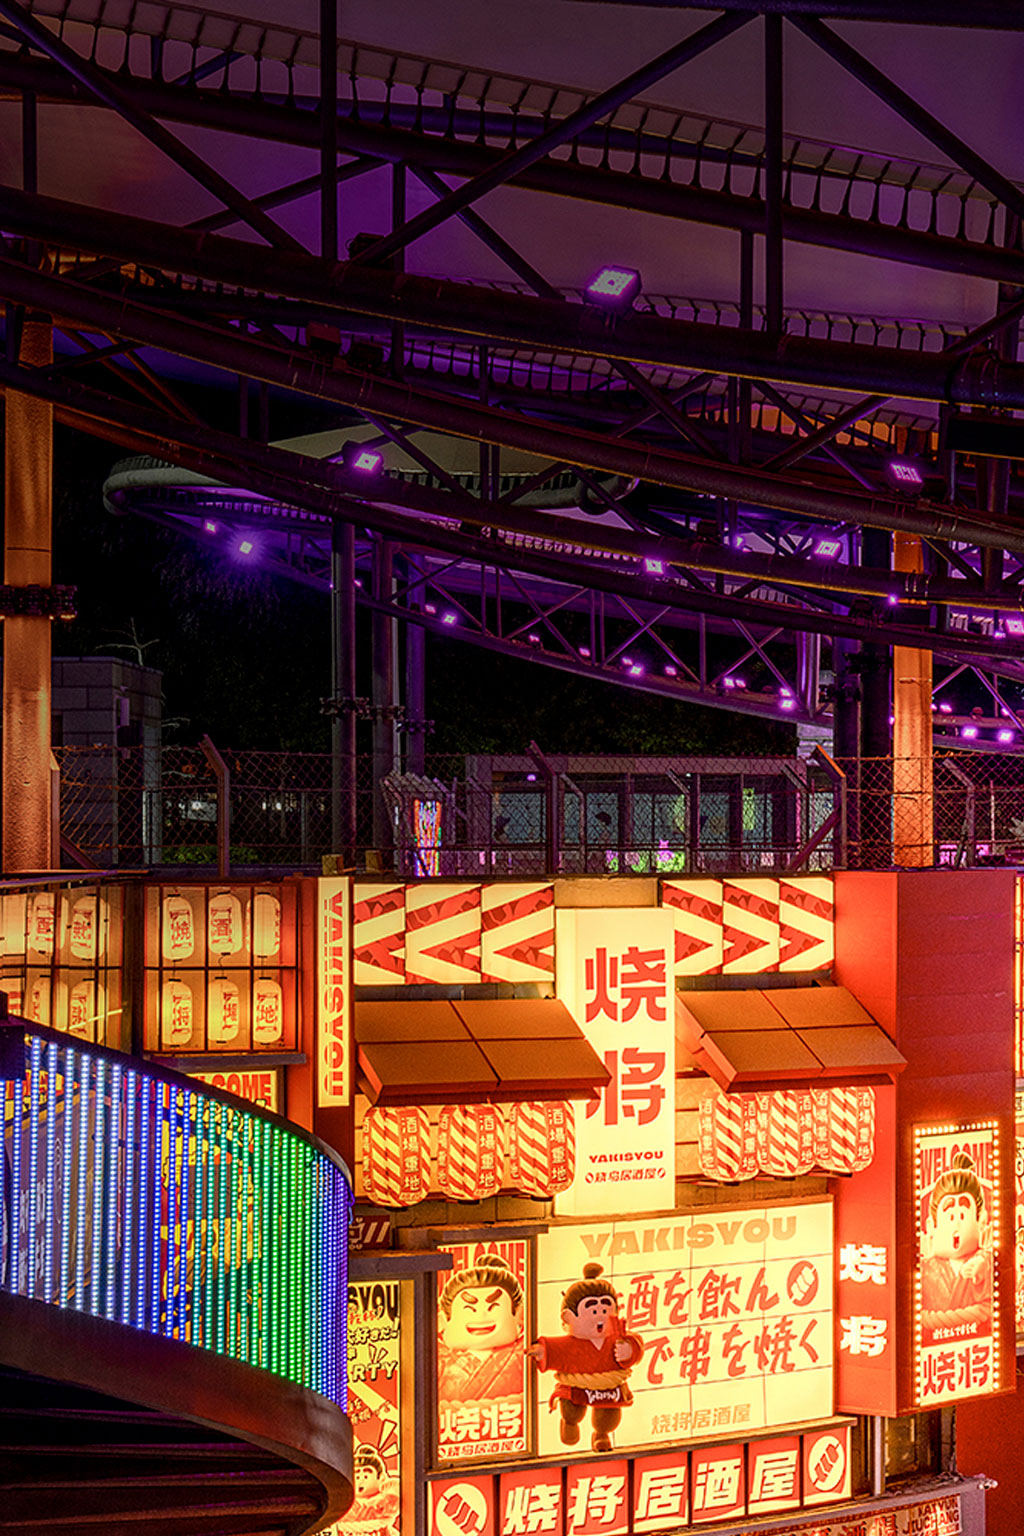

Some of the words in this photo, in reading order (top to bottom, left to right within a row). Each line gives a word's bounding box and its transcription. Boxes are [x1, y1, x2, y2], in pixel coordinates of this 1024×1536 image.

[322, 890, 344, 1098] YAKISYOU
[584, 946, 667, 1128] 烧将
[588, 1150, 664, 1164] YAKISYOU
[579, 1215, 797, 1258] YAKISYOU
[838, 1243, 887, 1358] 烧将
[642, 1315, 820, 1385] で串を焼く
[922, 1344, 991, 1398] 烧将
[440, 1402, 522, 1445] 烧将
[650, 1403, 751, 1436] 烧将居酒屋
[502, 1449, 799, 1536] 烧将居酒屋
